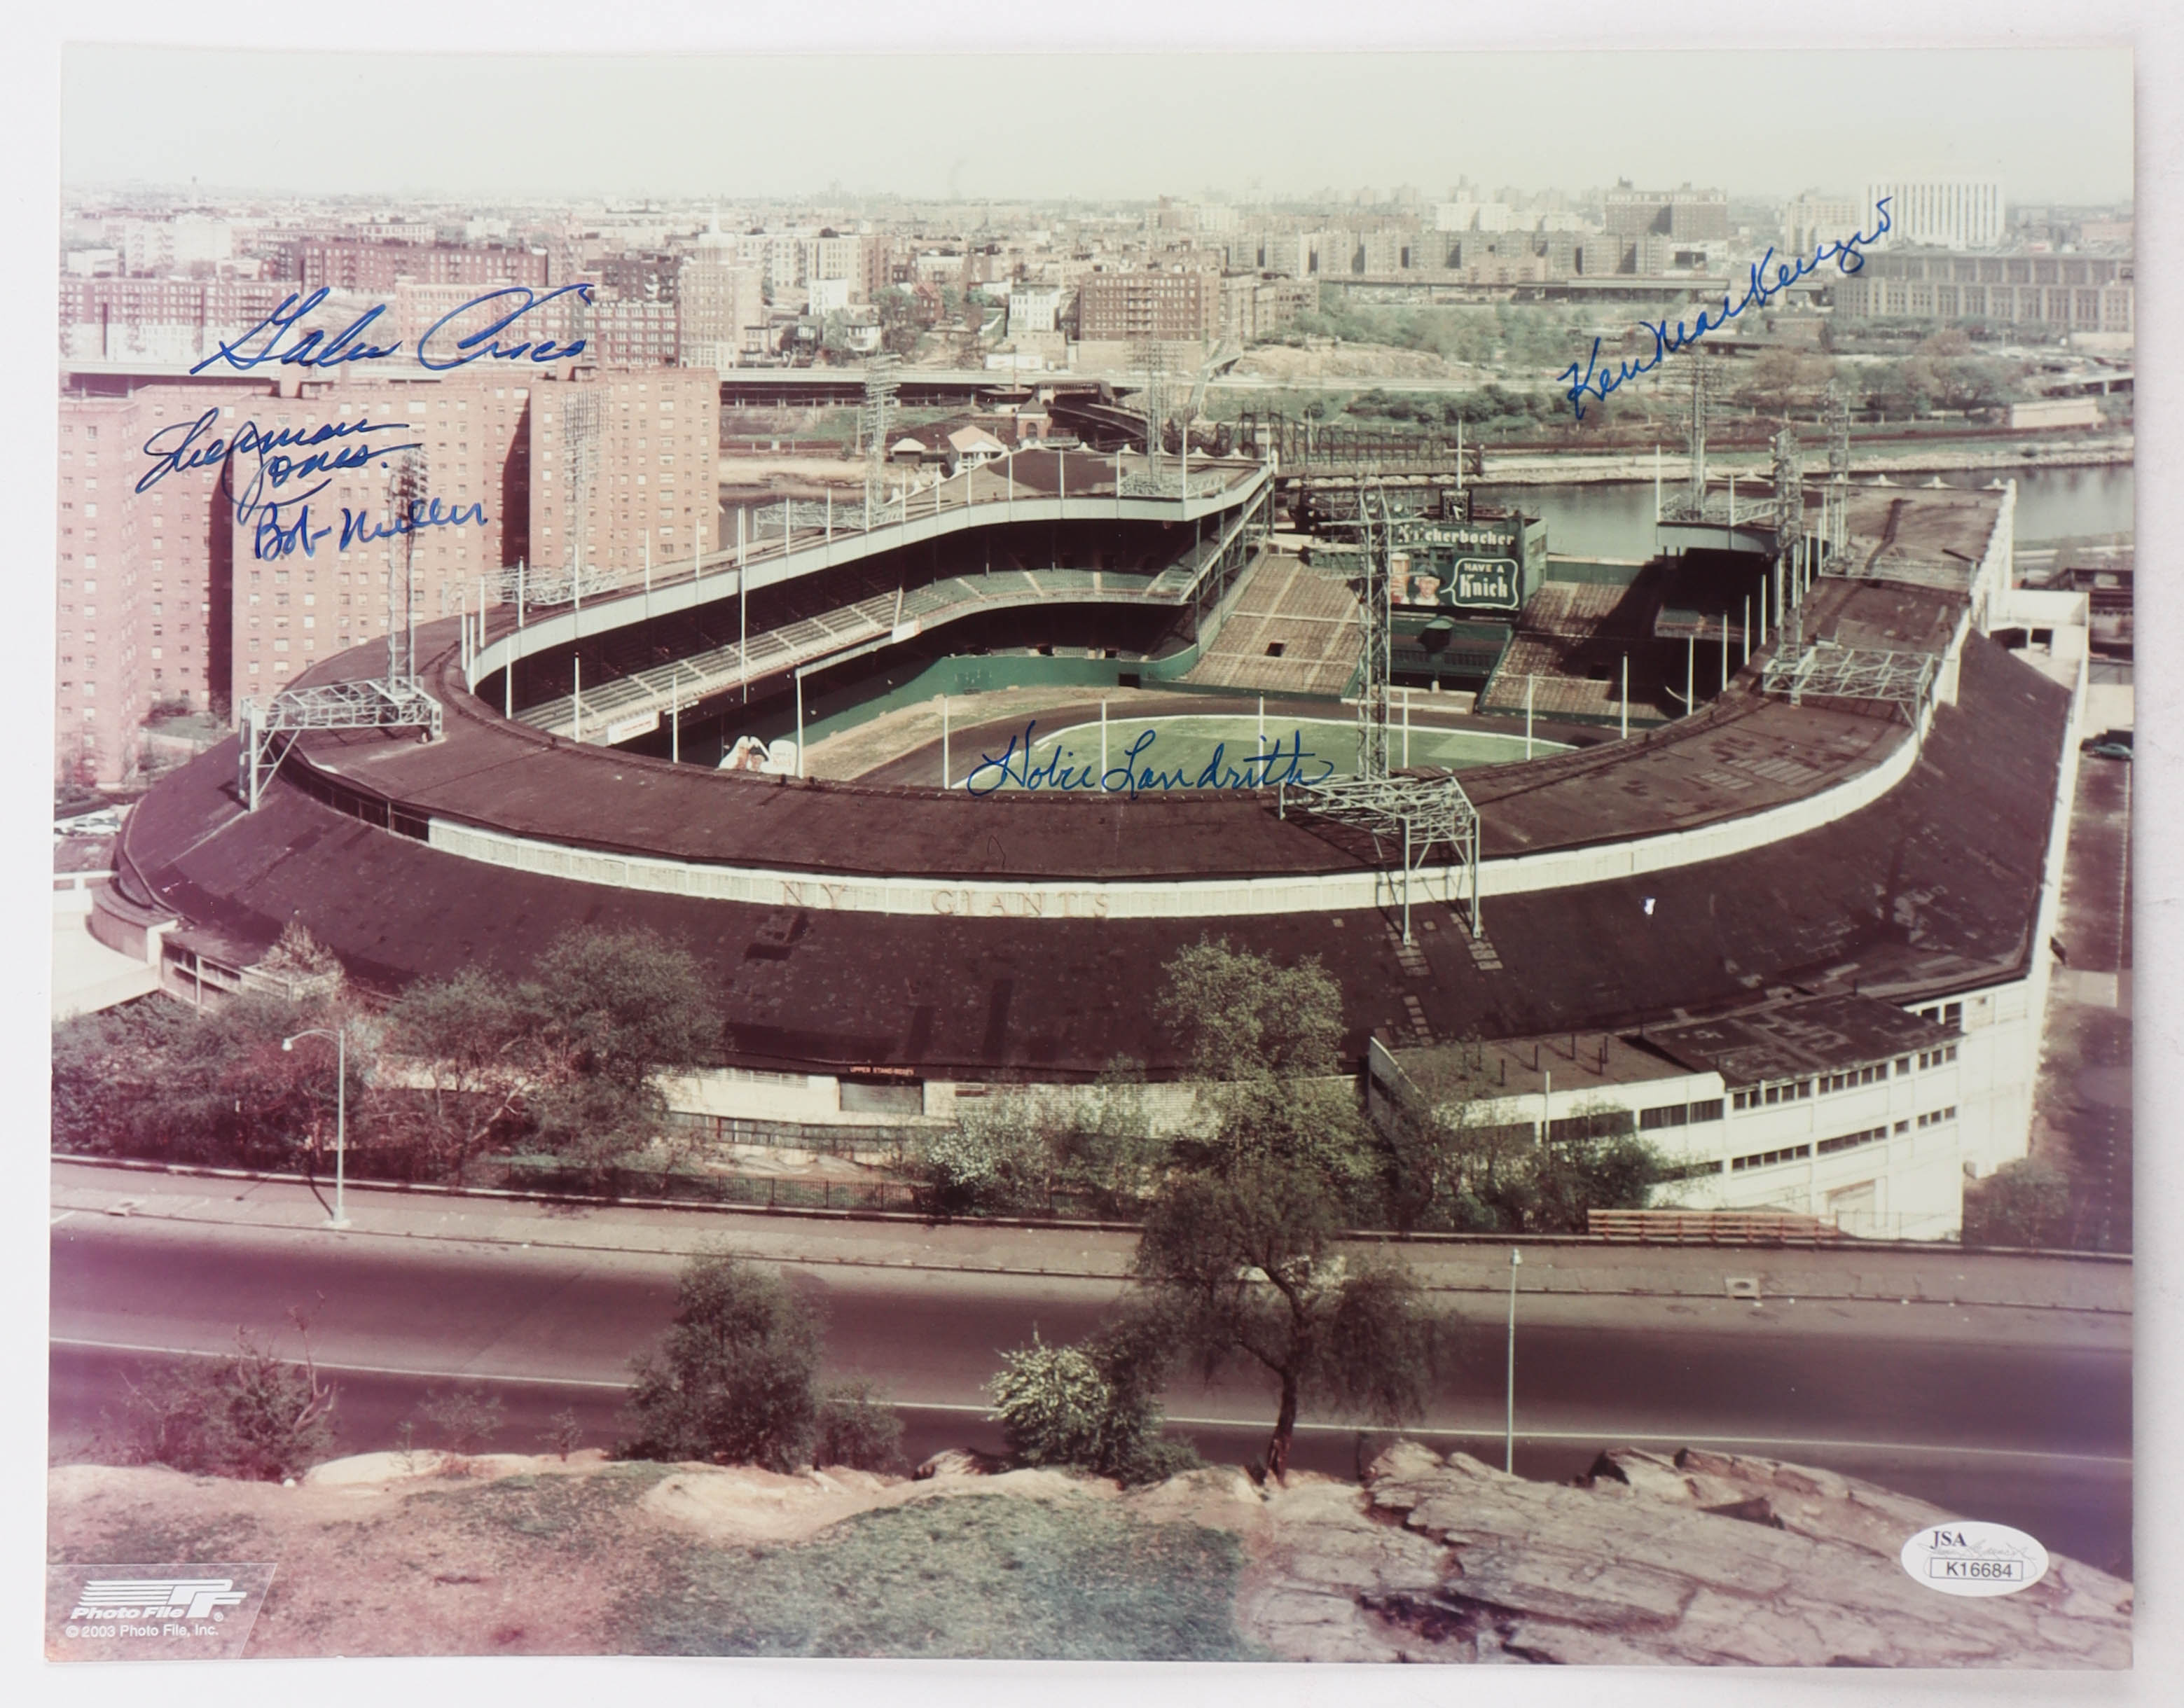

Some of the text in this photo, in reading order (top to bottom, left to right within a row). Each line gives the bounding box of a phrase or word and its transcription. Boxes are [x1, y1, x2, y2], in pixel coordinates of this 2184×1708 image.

[255, 501, 331, 561] Bob
[1464, 562, 1505, 574] HAVE A
[967, 720, 1334, 800] Hobie Landrith
[932, 889, 1110, 917] GIANTS
[1930, 1530, 1967, 1550] JSA
[1947, 1561, 2012, 1578] K16684
